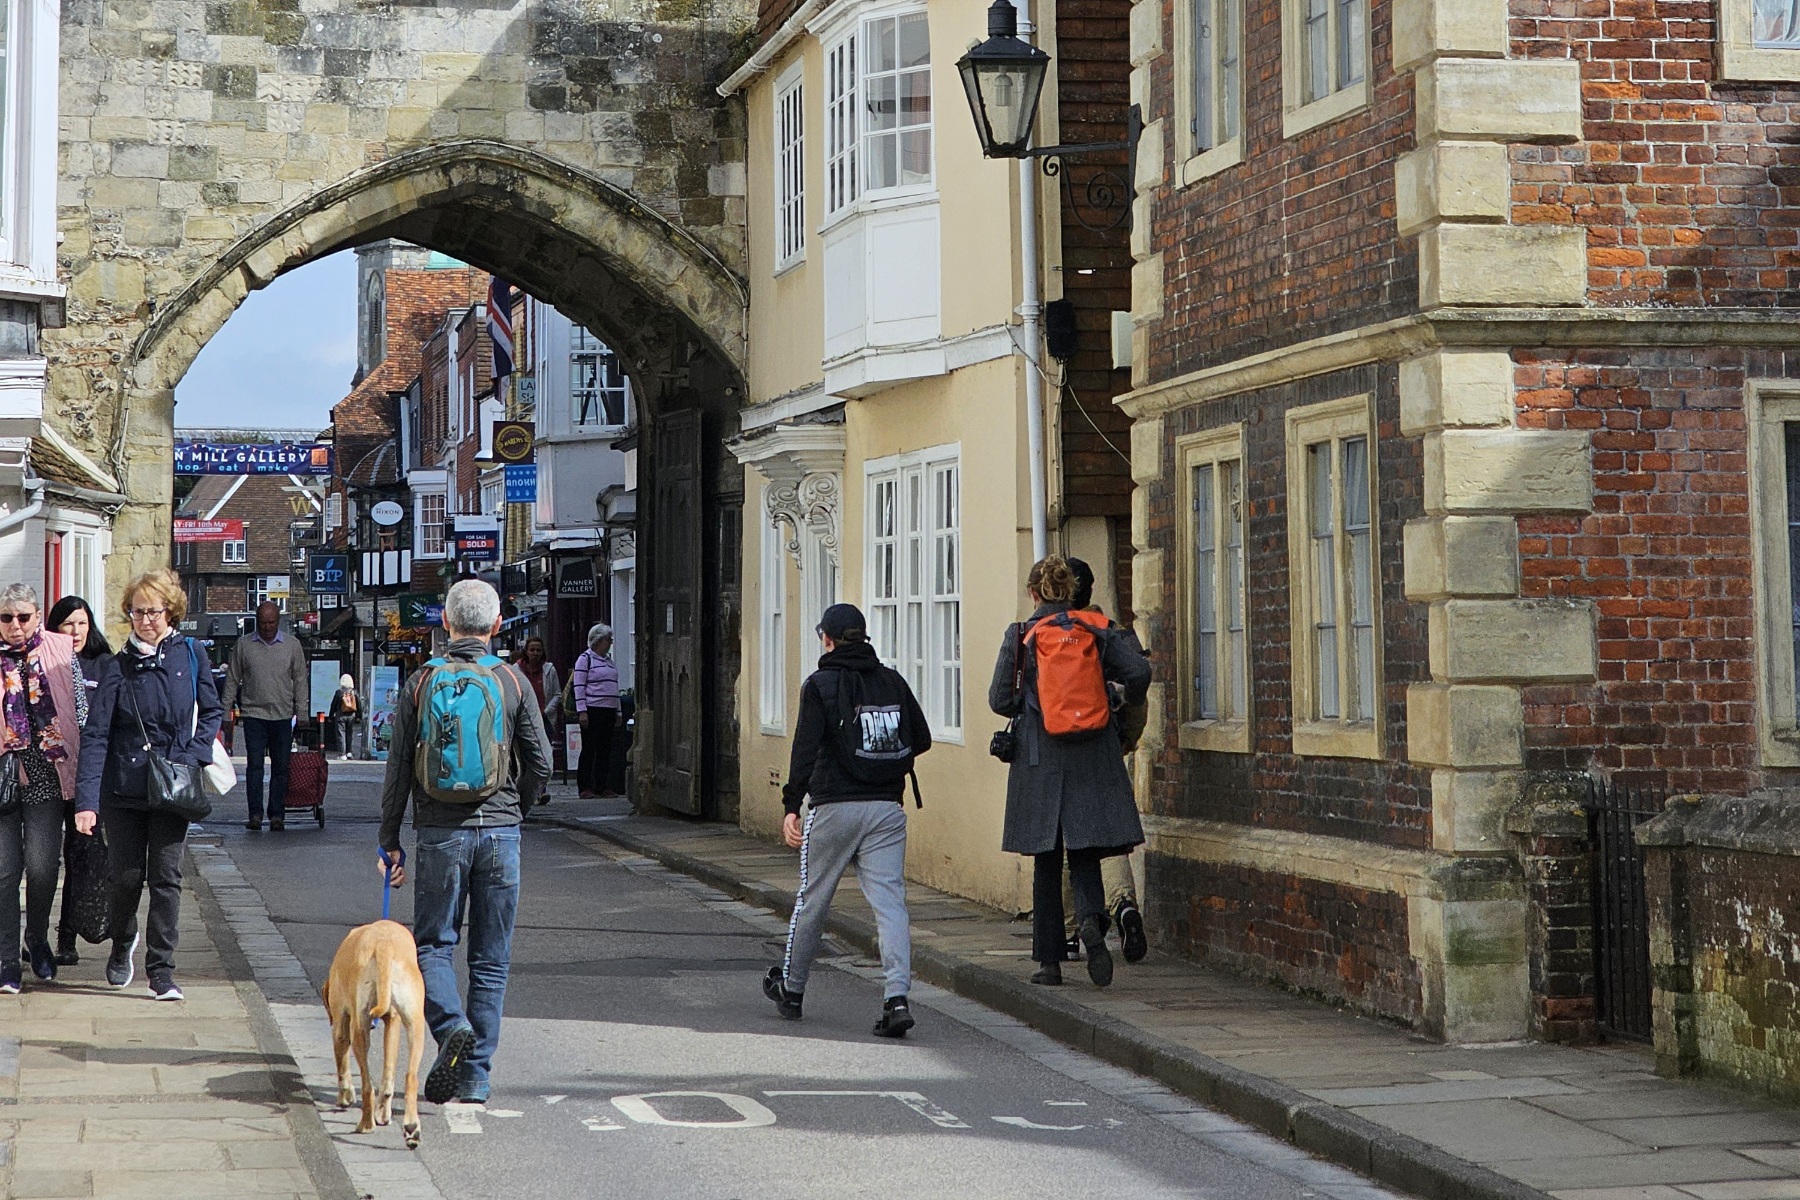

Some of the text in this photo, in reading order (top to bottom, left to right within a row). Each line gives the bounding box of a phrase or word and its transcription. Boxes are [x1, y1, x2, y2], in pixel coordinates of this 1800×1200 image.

[191, 452, 228, 462] MILL
[236, 451, 307, 463] GALLERY
[218, 463, 238, 472] eat
[257, 462, 289, 472] make
[213, 521, 228, 529] May
[314, 569, 343, 582] BTP
[561, 585, 594, 593] GALLERY
